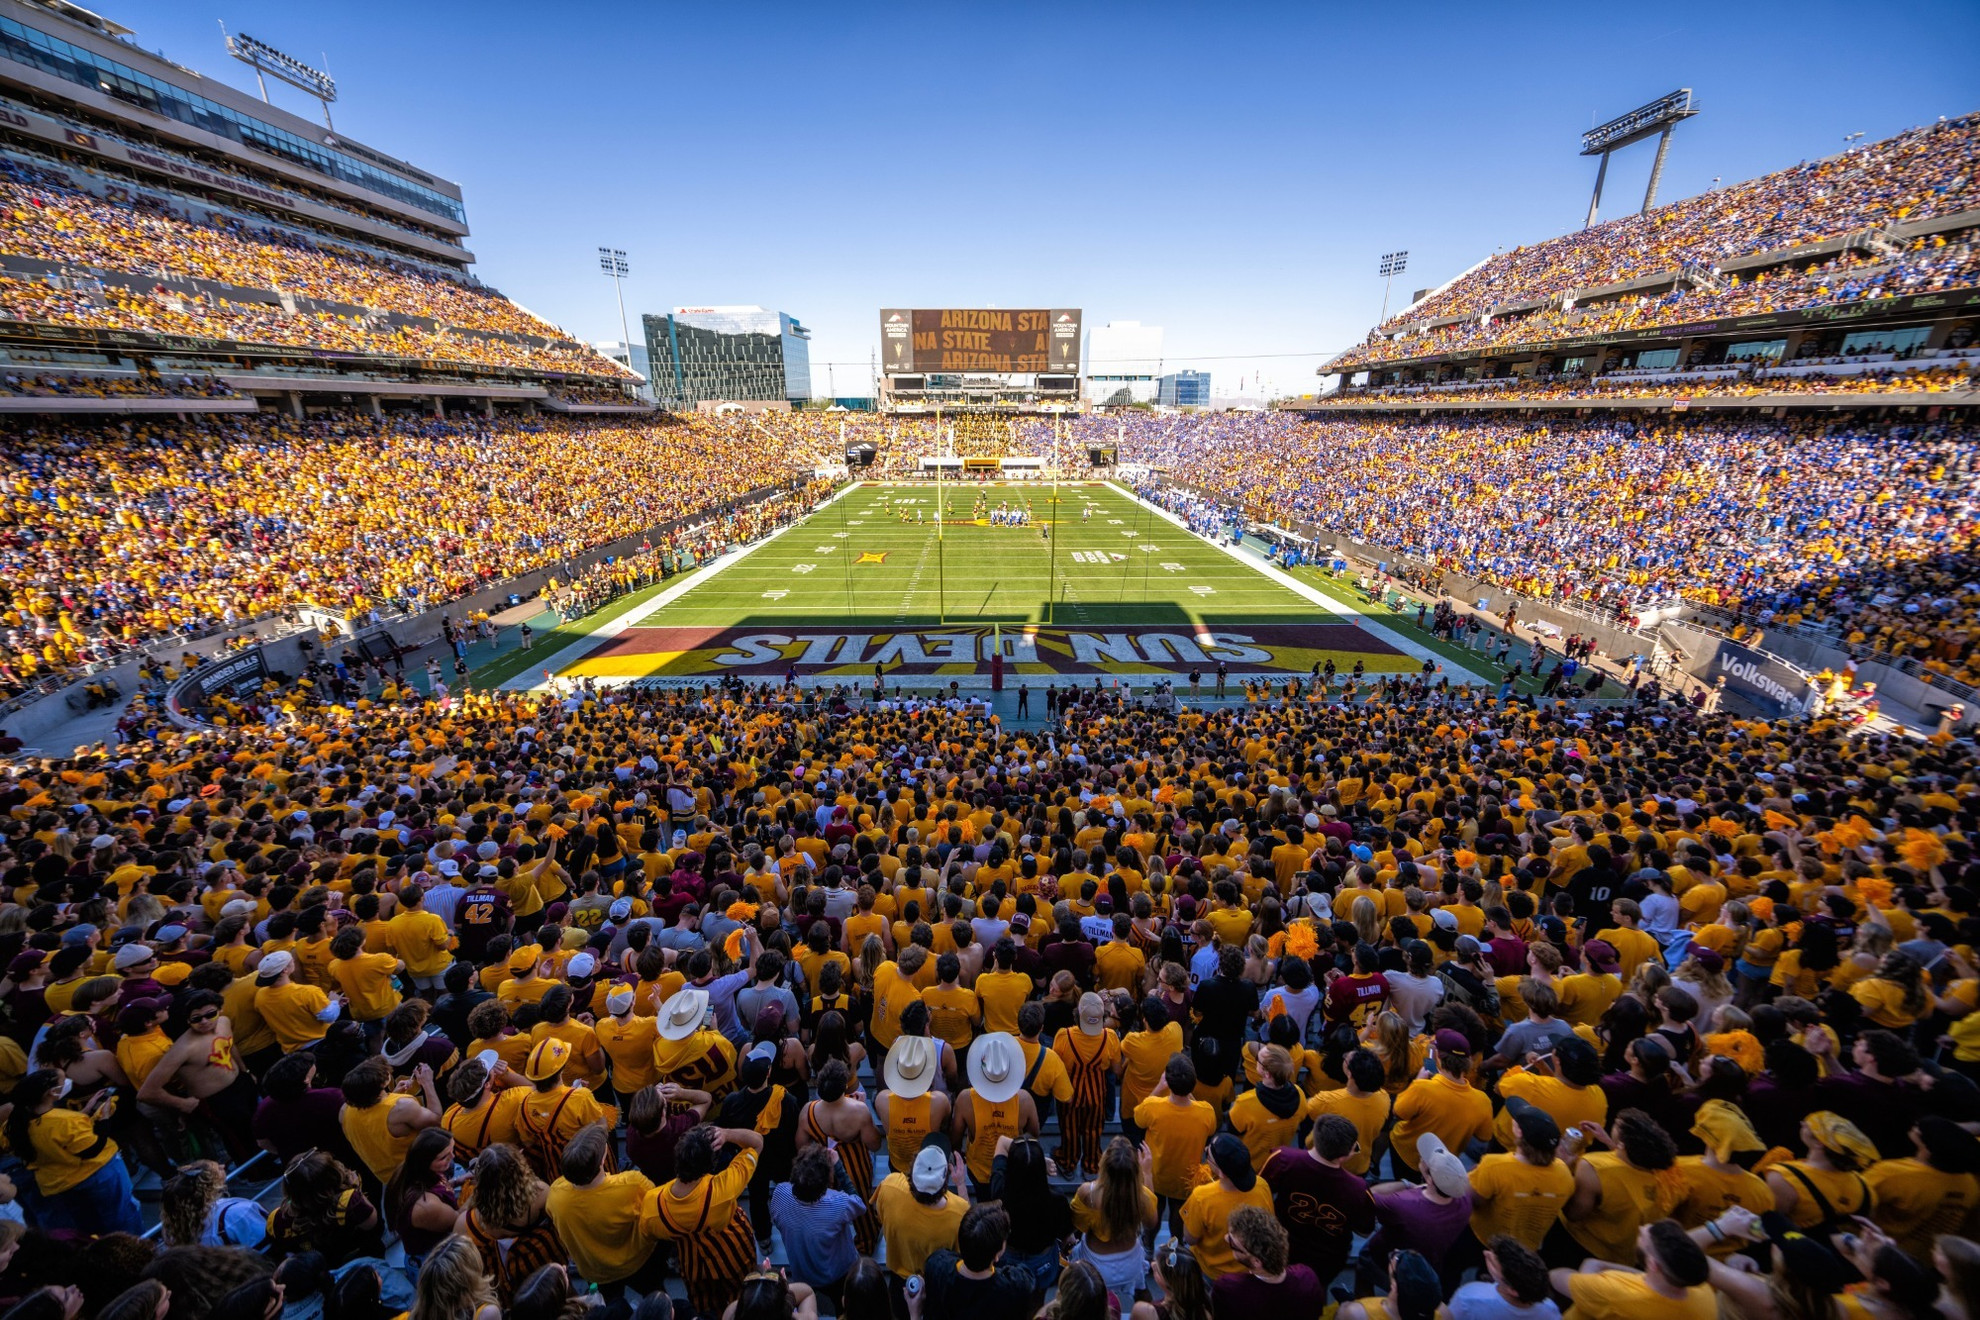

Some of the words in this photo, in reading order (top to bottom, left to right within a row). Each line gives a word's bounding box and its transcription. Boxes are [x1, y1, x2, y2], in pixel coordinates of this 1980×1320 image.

[127, 149, 168, 170] HOME
[170, 163, 187, 175] OF
[188, 168, 213, 183] THE
[214, 176, 236, 190] ASU
[237, 183, 259, 197] SUN
[261, 191, 295, 208] DEVILS
[940, 309, 1012, 332] ARIZONA
[1662, 327, 1683, 336] EXACT
[1684, 323, 1718, 332] SCIENCES
[236, 344, 282, 354] SUPPORTING
[913, 332, 937, 350] NA
[943, 331, 991, 351] STATE
[941, 352, 1012, 372] ARIZONA
[712, 632, 1042, 666] DEVILS
[1072, 632, 1276, 664] SUN
[201, 665, 236, 689] BRANDED
[234, 655, 259, 671] BILLS
[466, 894, 496, 903] TILLMAN
[1589, 886, 1611, 901] 10
[464, 903, 494, 925] 42
[575, 908, 604, 927] 22
[1088, 926, 1114, 940] TILLMAN
[1356, 984, 1382, 998] TILLMAN
[1349, 1000, 1383, 1028] 42
[1287, 1191, 1347, 1238] 22
